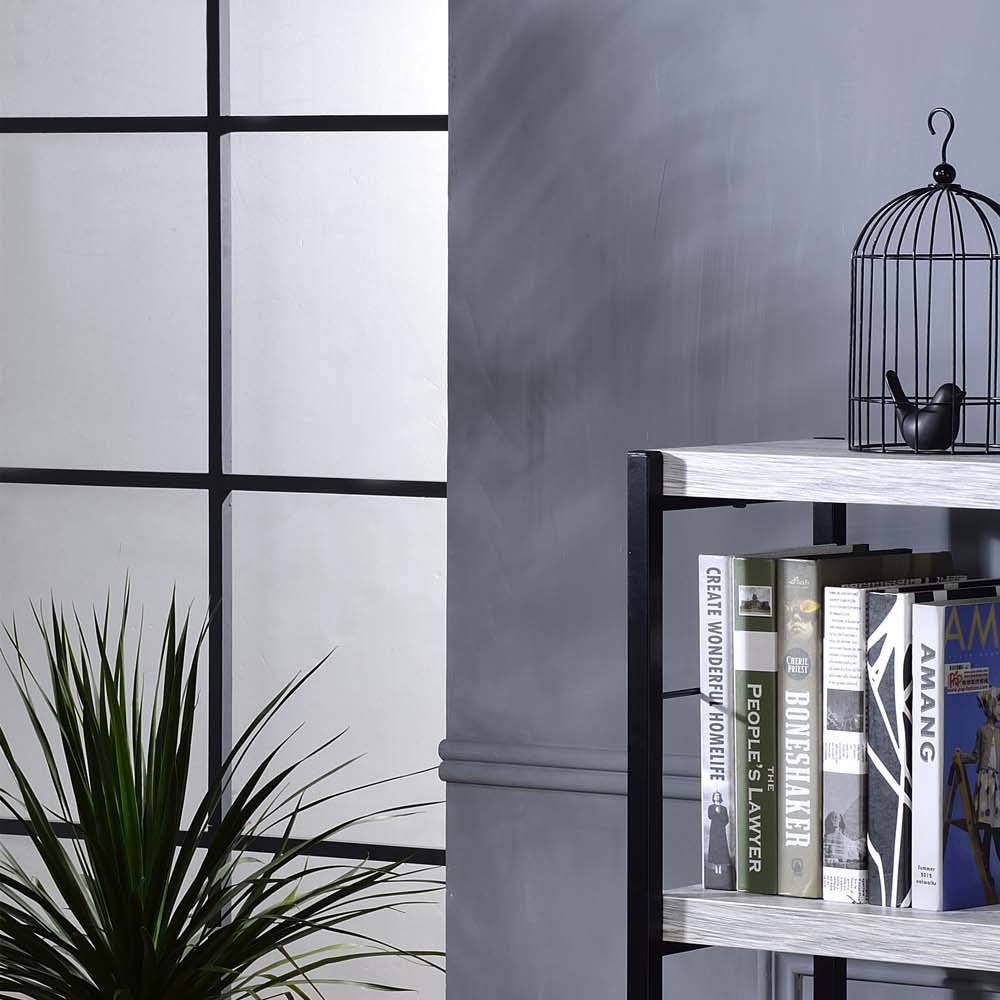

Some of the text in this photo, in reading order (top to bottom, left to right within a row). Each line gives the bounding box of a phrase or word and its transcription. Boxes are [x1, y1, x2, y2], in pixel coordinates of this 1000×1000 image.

[706, 566, 725, 782] CREATE WONDERFUL HOMELIFE
[920, 643, 937, 764] AMANG
[747, 683, 763, 873] PEOPLE'S LAWYER
[767, 766, 775, 792] THE
[784, 690, 811, 847] BONESHAKER
